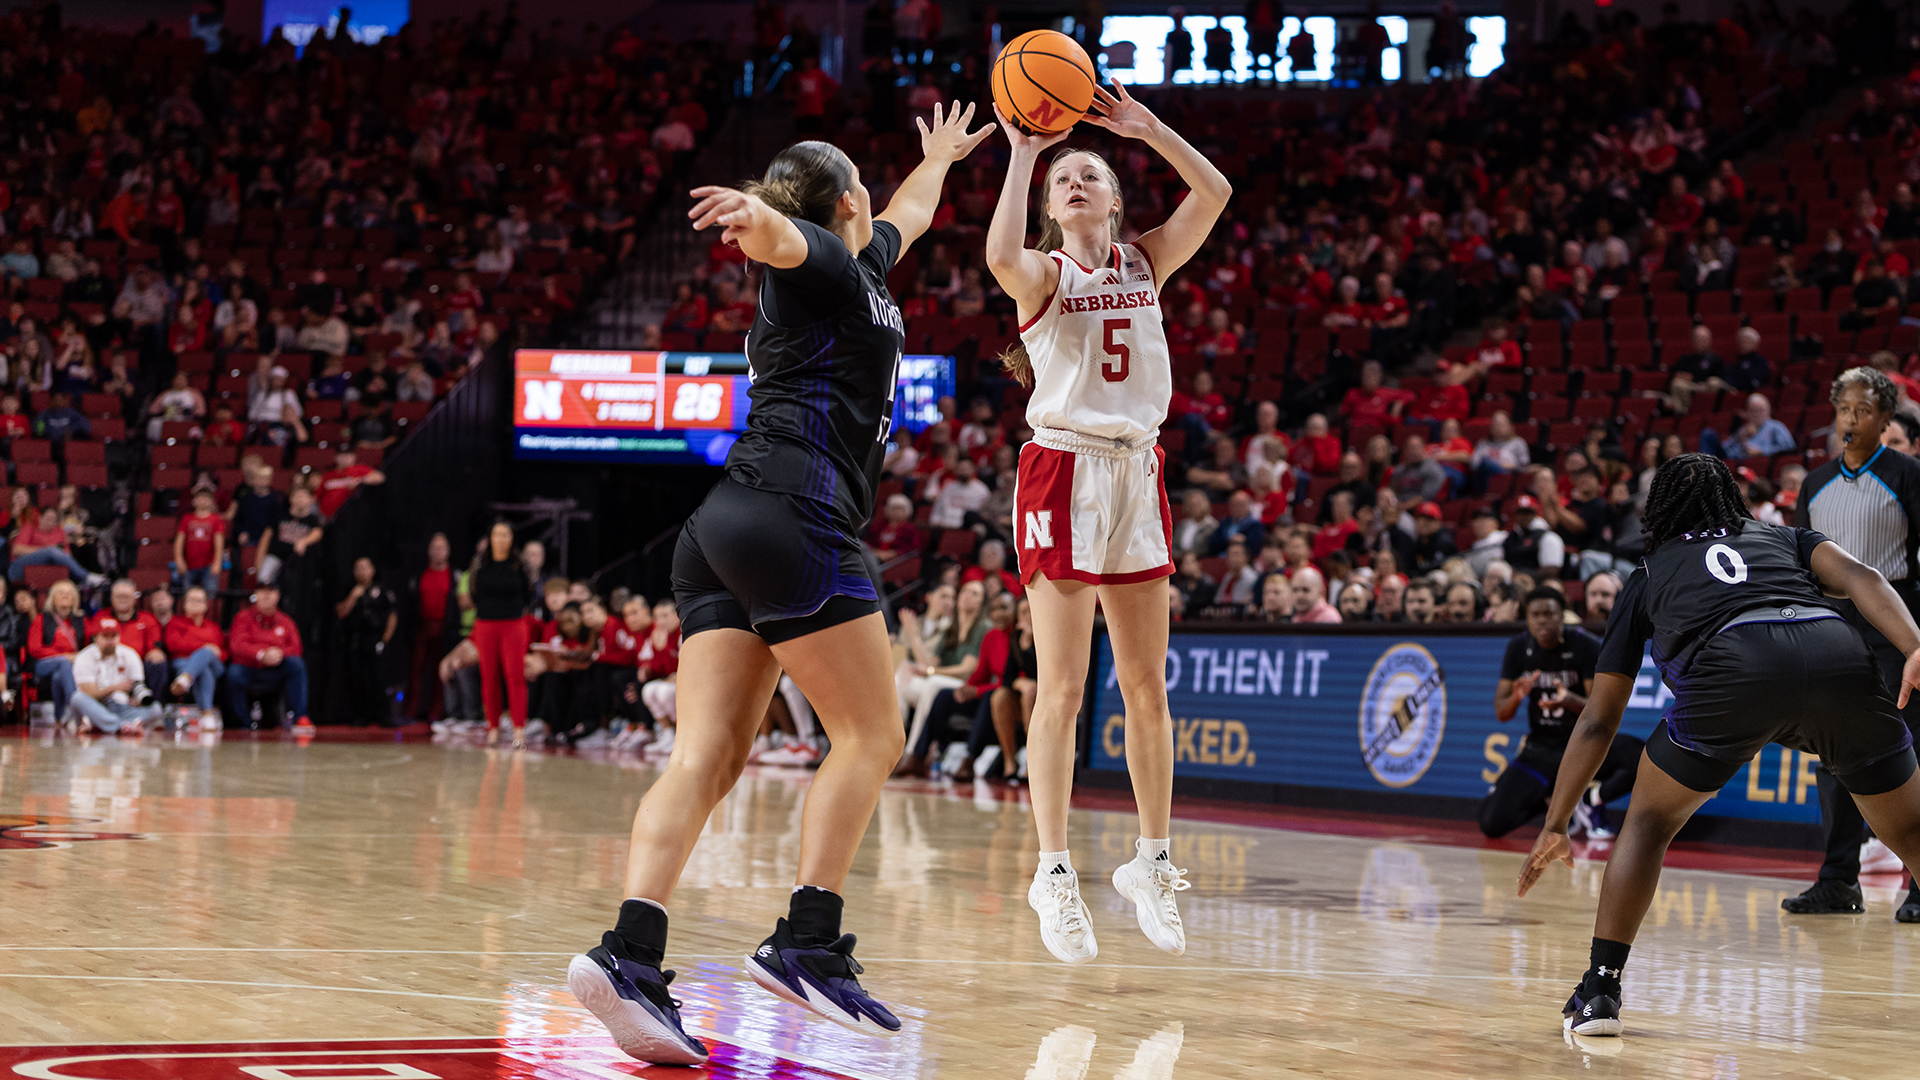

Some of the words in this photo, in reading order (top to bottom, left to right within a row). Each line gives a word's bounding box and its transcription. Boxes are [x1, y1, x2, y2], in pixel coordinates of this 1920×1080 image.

[1027, 96, 1064, 128] N
[1101, 318, 1132, 383] 5
[523, 380, 564, 421] N
[671, 382, 724, 421] 26
[1024, 509, 1055, 550] N
[1704, 543, 1748, 585] 0
[1188, 648, 1284, 696] THEN
[1293, 650, 1330, 697] IT
[1102, 713, 1257, 768] CKED.
